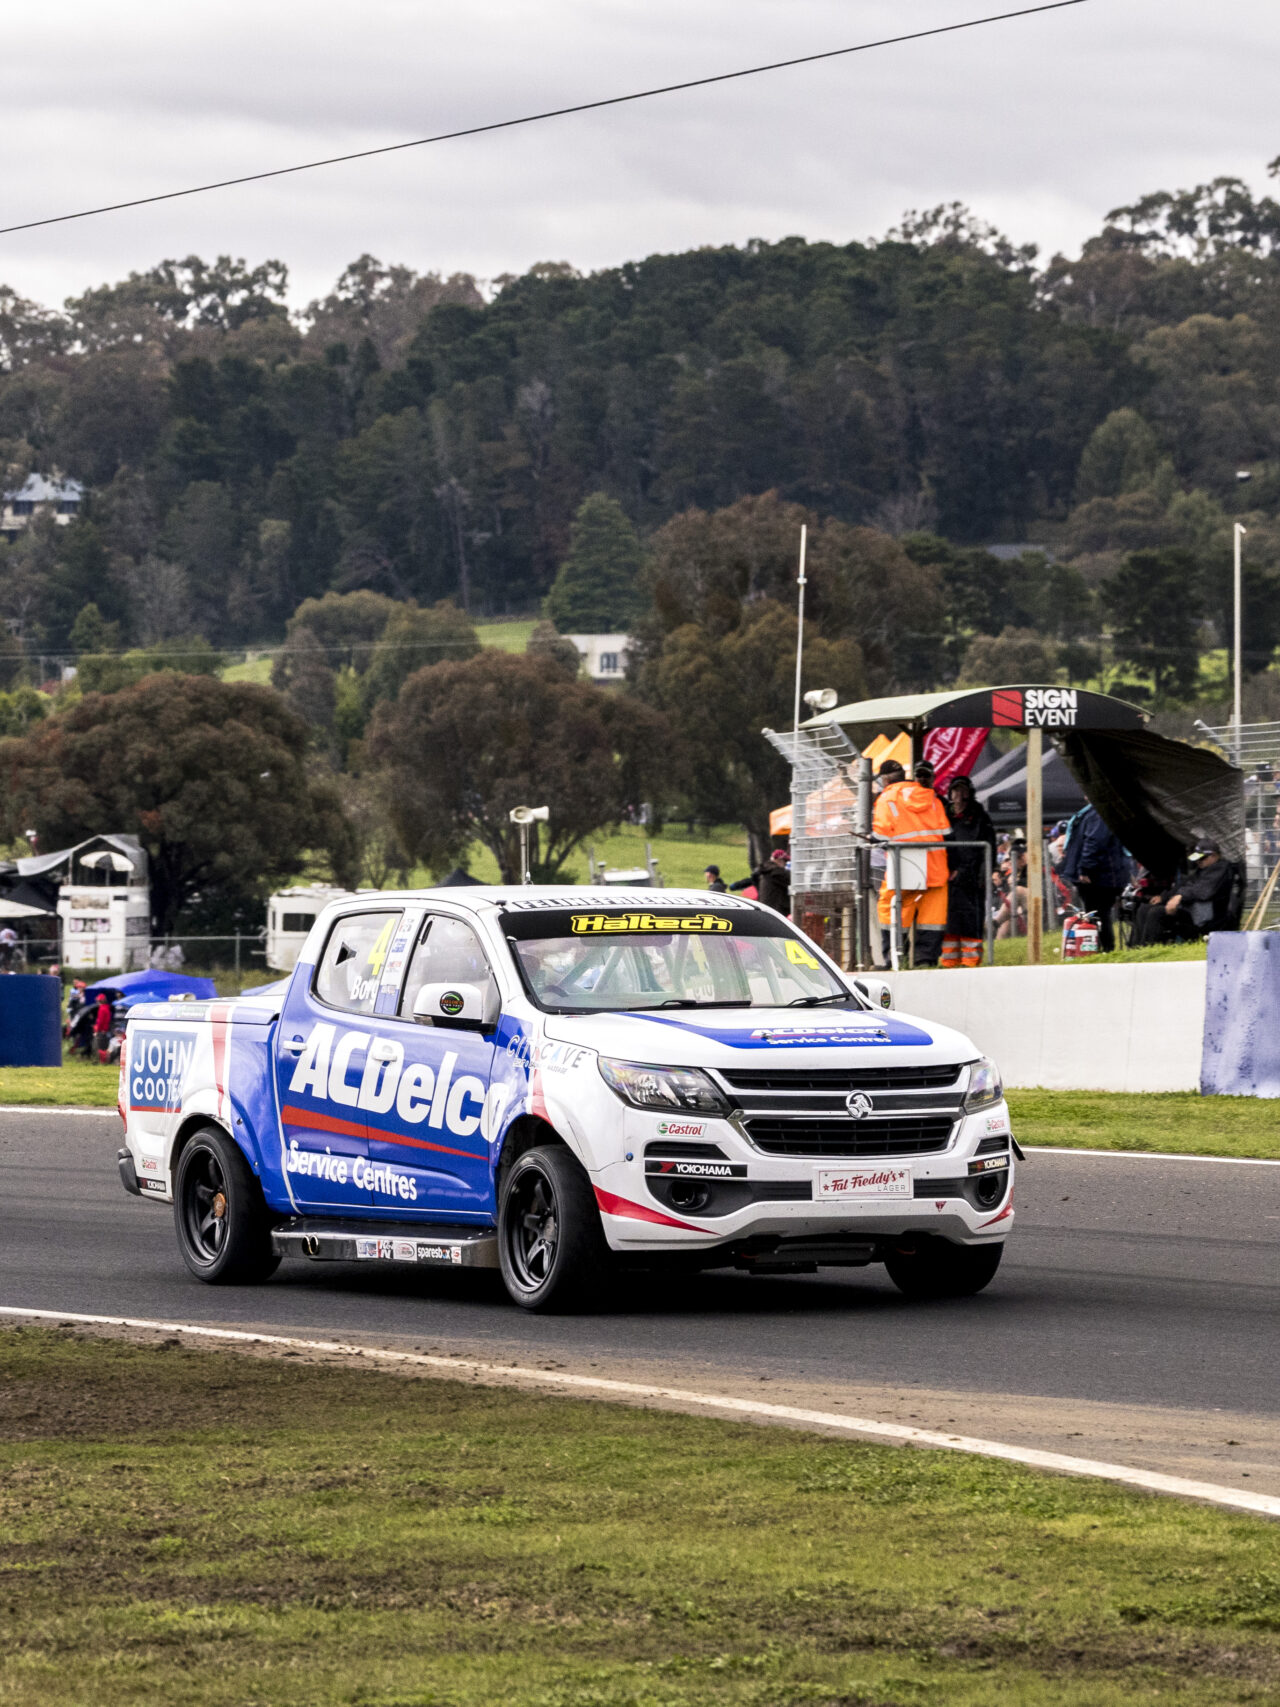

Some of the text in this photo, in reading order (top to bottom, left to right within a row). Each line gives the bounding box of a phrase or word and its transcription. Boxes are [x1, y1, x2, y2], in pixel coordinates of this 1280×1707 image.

[1024, 688, 1078, 709] SIGN
[1024, 709, 1078, 726] EVENT
[573, 914, 731, 932] Haltech
[367, 918, 396, 976] 4
[783, 940, 821, 970] 4
[133, 1038, 194, 1075] JOHN
[288, 1022, 511, 1144] ACDelco
[668, 1123, 702, 1136] Castrol
[286, 1139, 418, 1201] Service Centres
[675, 1163, 732, 1176] YOKOHAMA
[832, 1170, 897, 1192] Fat Freddy's
[877, 1183, 906, 1192] LAGER
[417, 1245, 451, 1259] sparesbox
